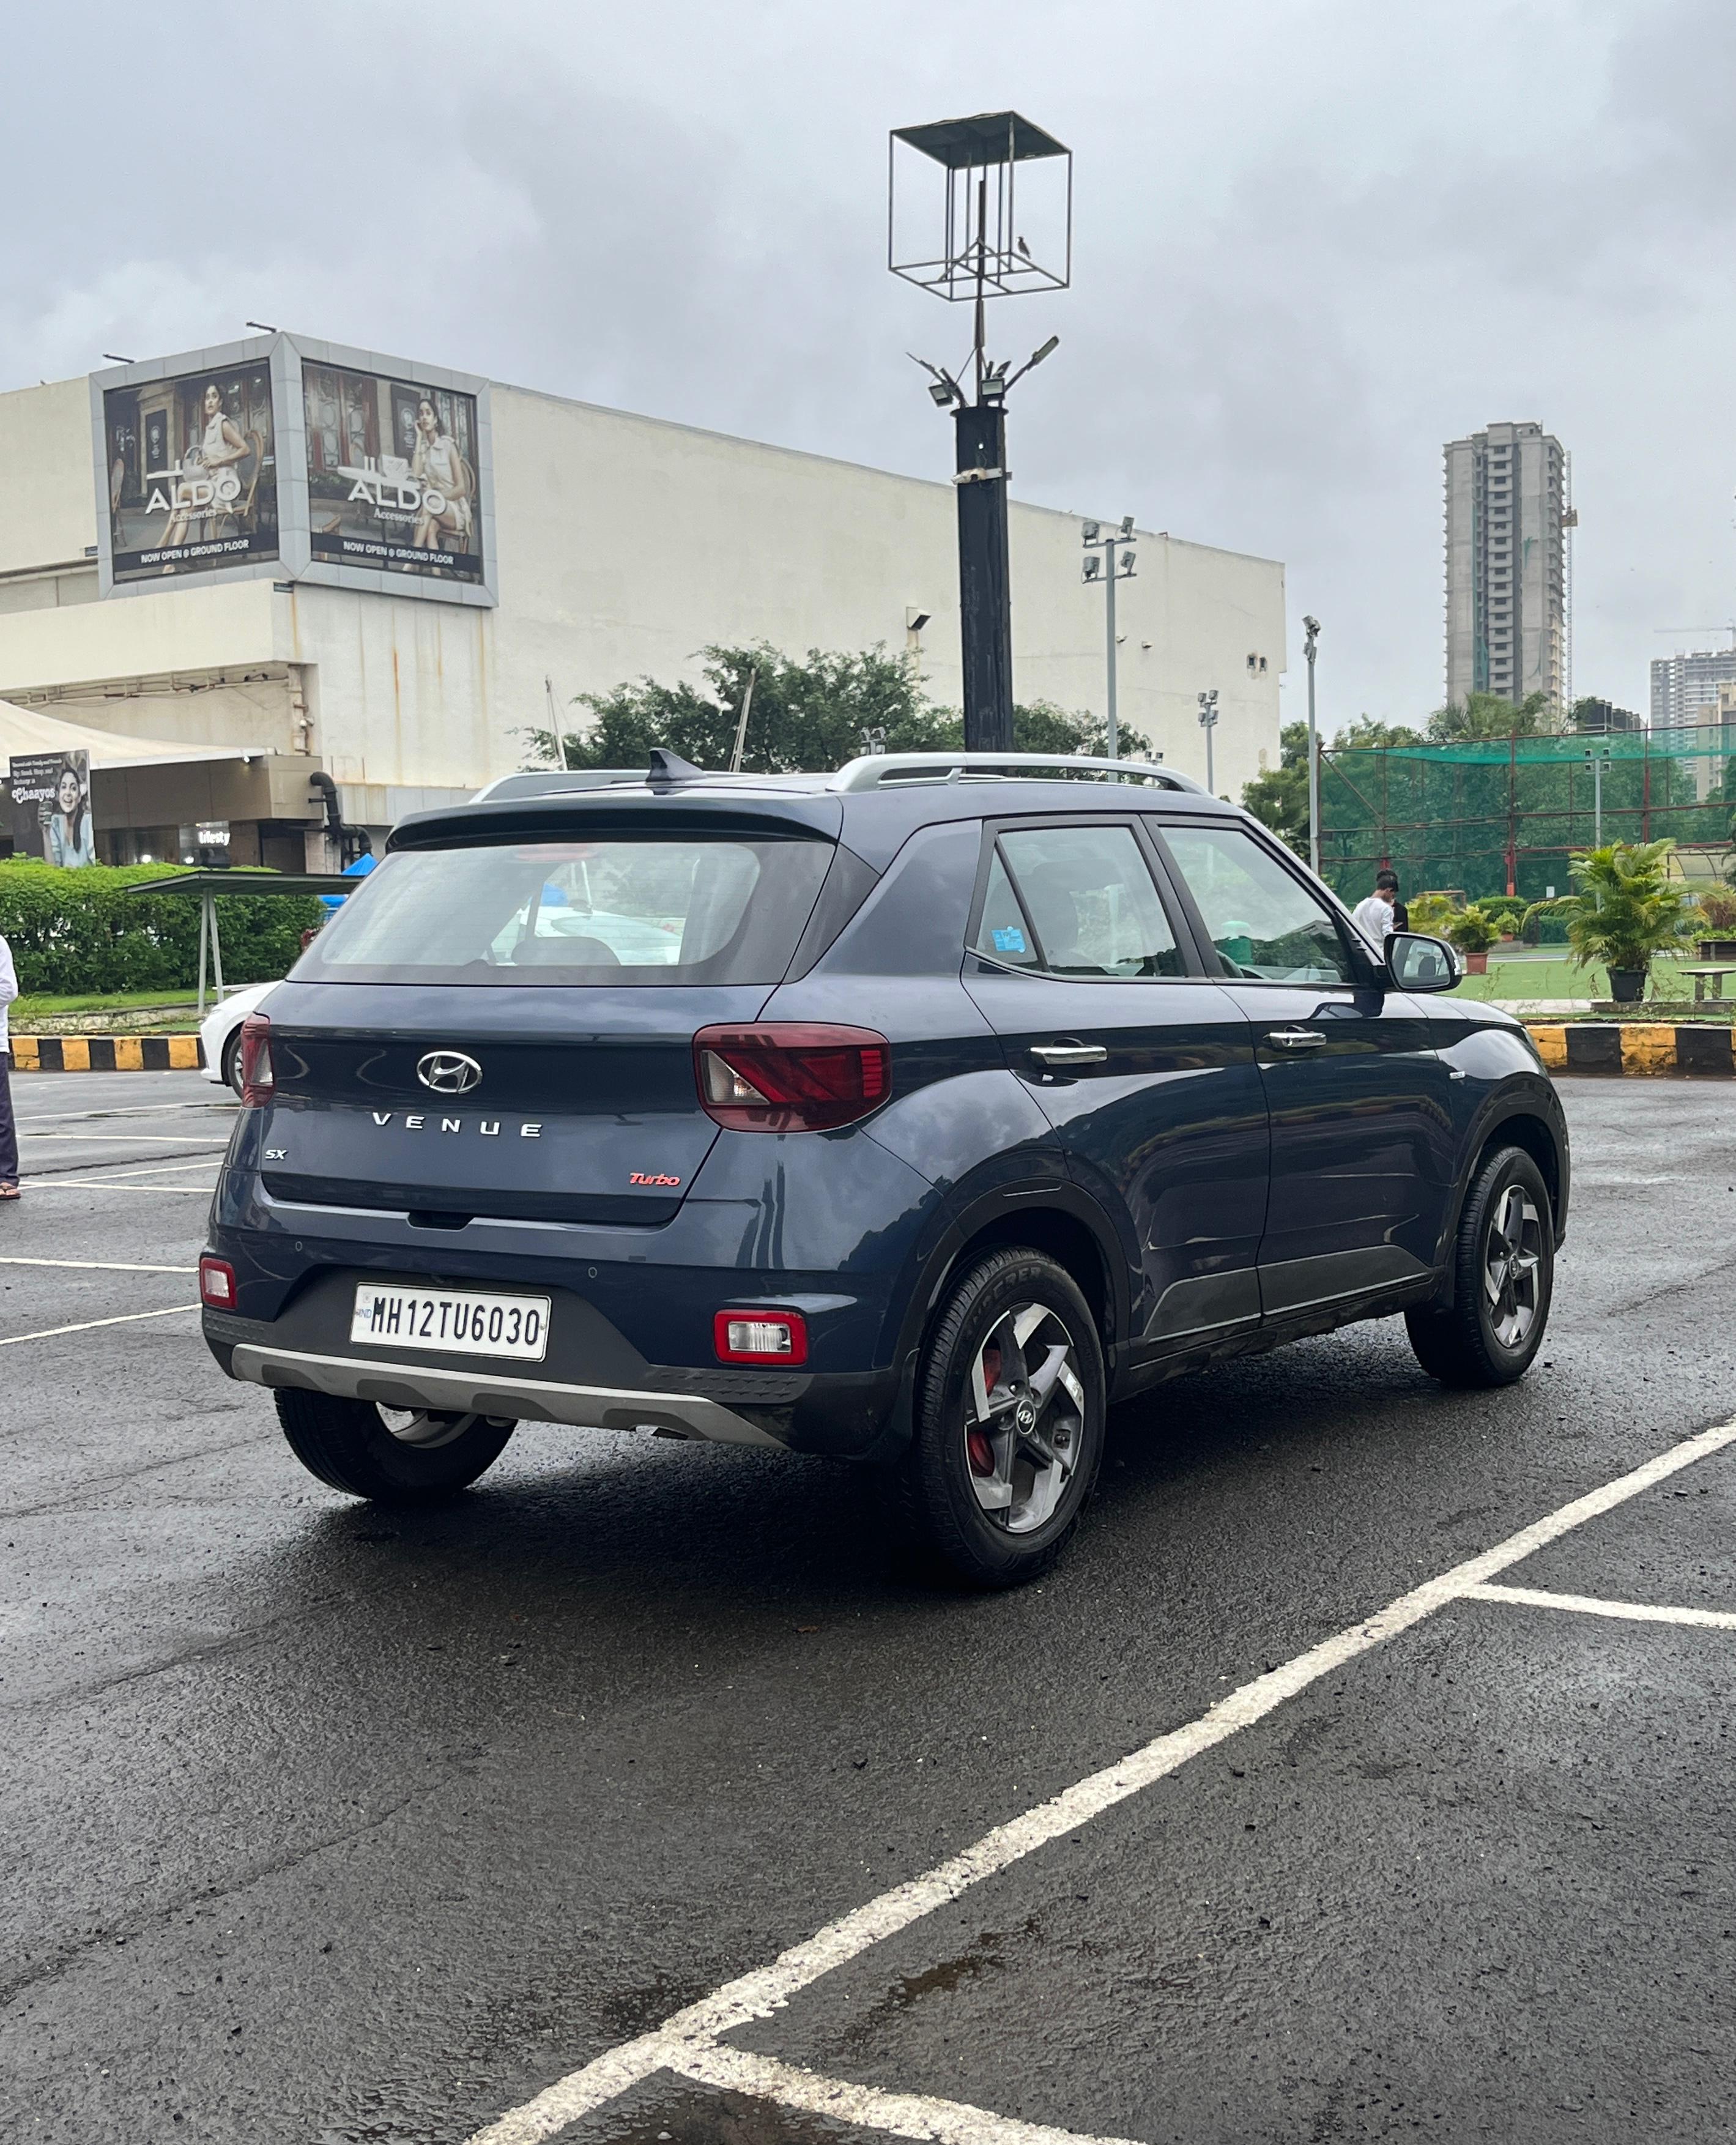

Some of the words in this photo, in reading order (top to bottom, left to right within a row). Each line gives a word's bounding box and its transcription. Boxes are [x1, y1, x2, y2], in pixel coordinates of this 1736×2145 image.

[145, 479, 241, 515] ALDO
[347, 478, 447, 515] ALDO
[171, 507, 217, 523] Accessories
[374, 508, 425, 525] Accessories
[141, 552, 160, 563] NOW
[161, 549, 182, 560] OPEN
[190, 543, 223, 556] GROUND
[224, 539, 250, 552] FLOOR
[343, 541, 365, 553] NOW
[365, 544, 388, 556] OPEN
[396, 549, 429, 562] GROUND
[429, 553, 454, 565] FLOOR
[12, 786, 56, 804] Chaayos
[373, 1112, 543, 1137] VENUE
[265, 1149, 288, 1160] SX
[629, 1172, 681, 1186] Turbo
[371, 1297, 540, 1345] MH12TU6030
